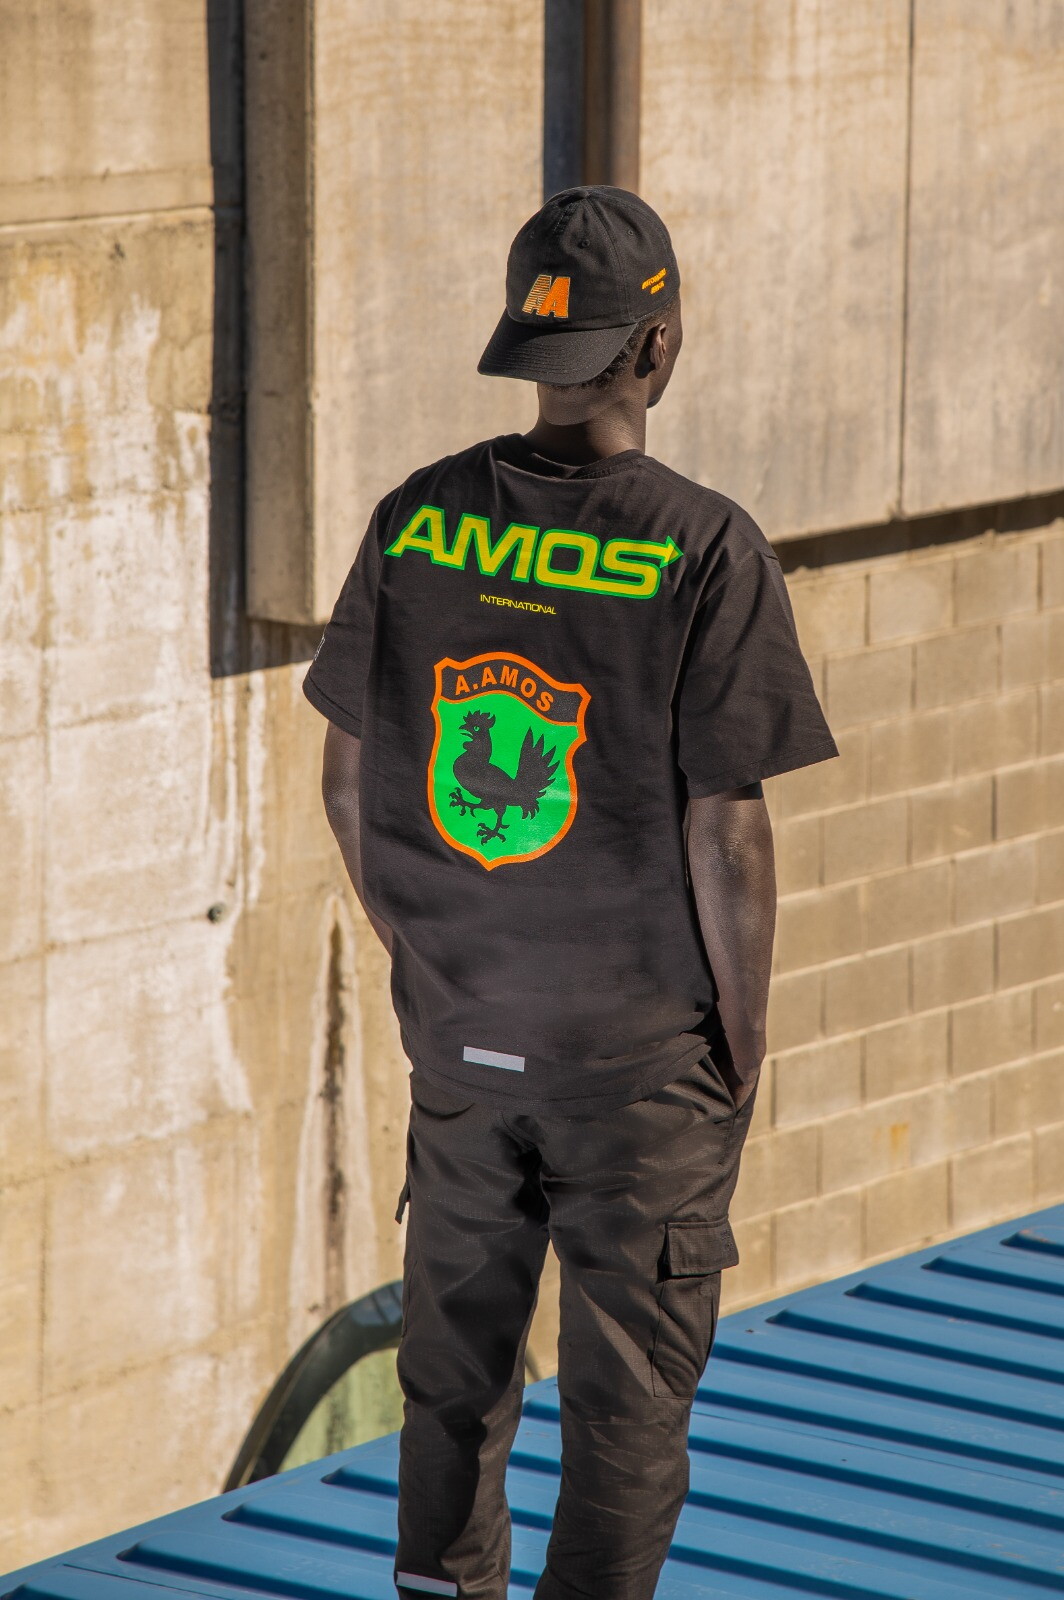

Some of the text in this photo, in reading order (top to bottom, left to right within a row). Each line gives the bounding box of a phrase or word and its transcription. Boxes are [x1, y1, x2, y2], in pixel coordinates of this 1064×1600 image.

[384, 504, 684, 600] AMOS
[479, 593, 557, 615] INTERNATIONAL
[454, 664, 555, 713] A.AMOS
